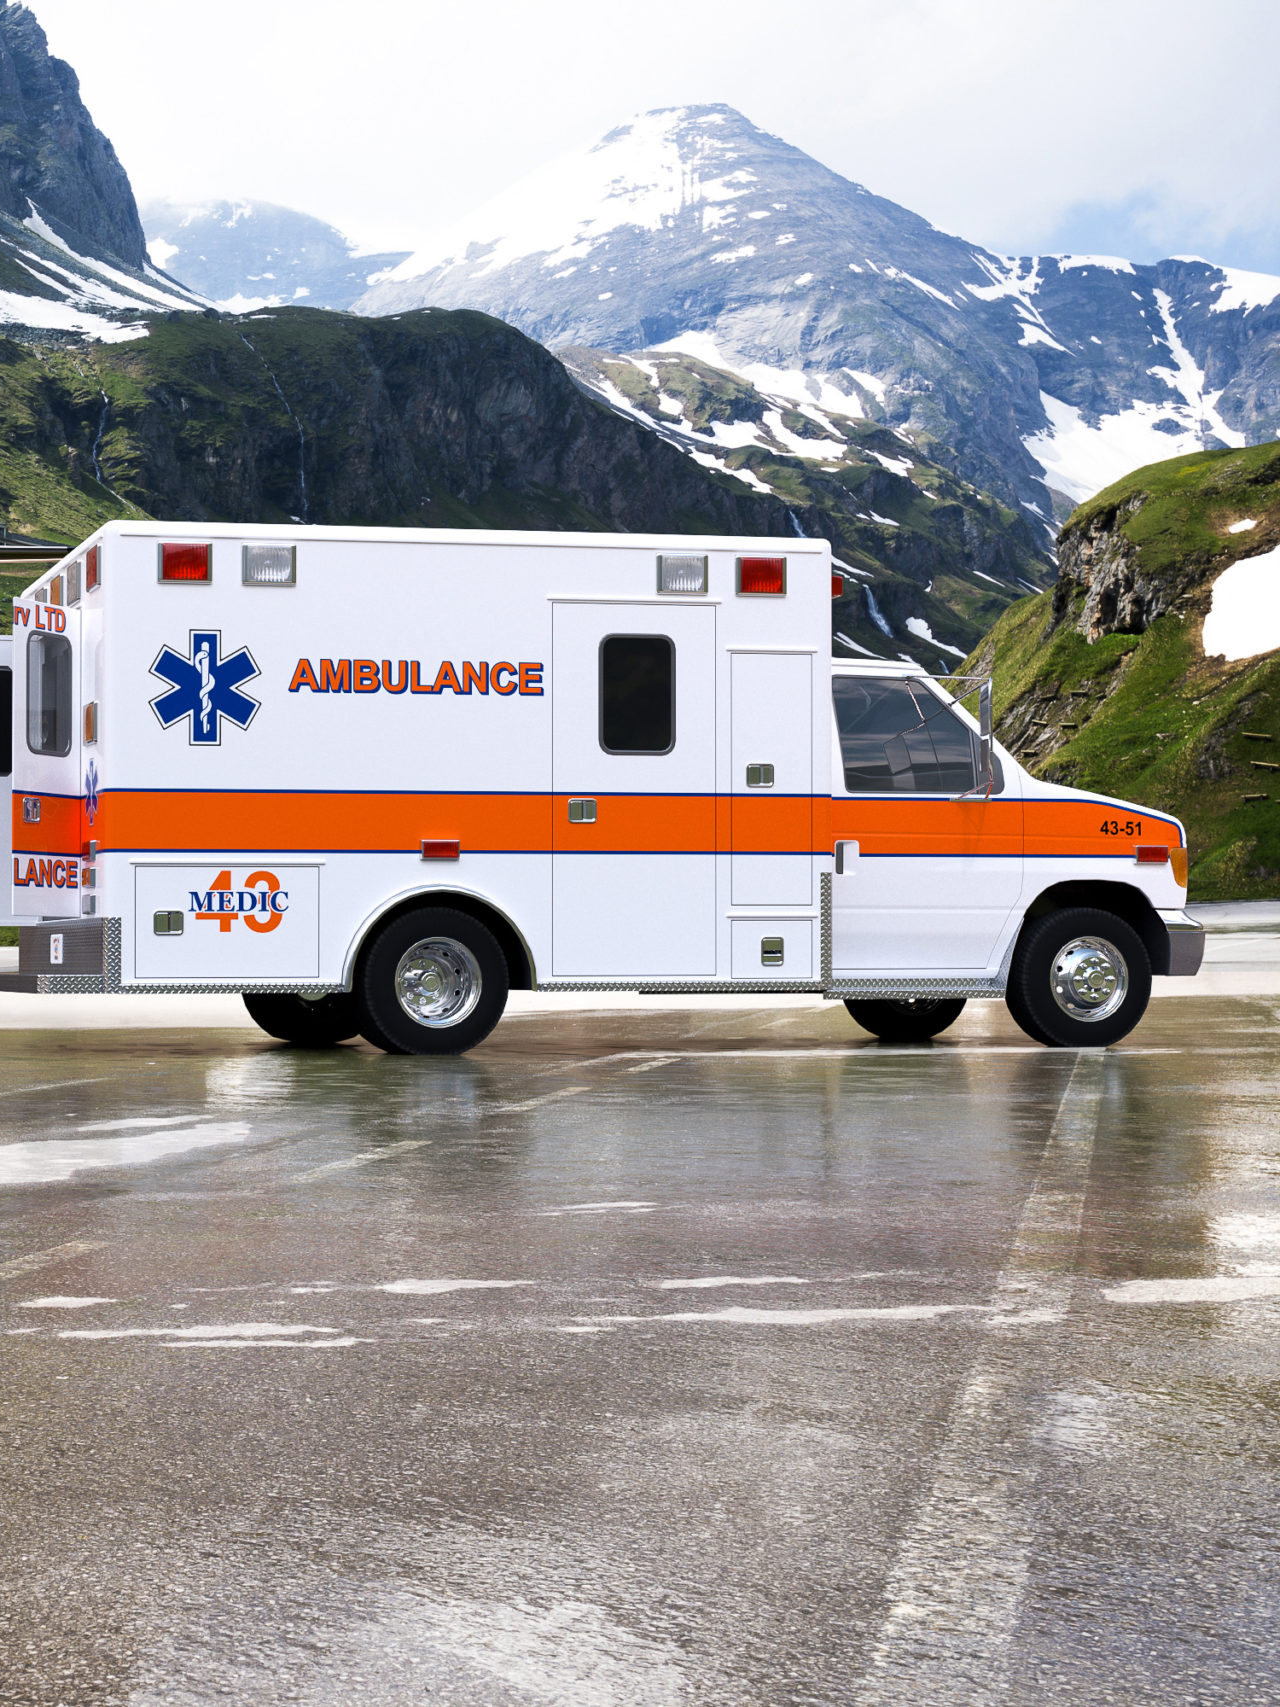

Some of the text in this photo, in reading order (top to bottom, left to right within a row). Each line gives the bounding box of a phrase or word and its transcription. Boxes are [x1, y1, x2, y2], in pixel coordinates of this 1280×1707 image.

[35, 604, 67, 633] LTD
[288, 658, 544, 697] AMBULANCE
[1100, 820, 1142, 836] 43-51
[13, 857, 79, 889] LANCE
[187, 891, 289, 912] MEDIC
[195, 870, 283, 933] 43
